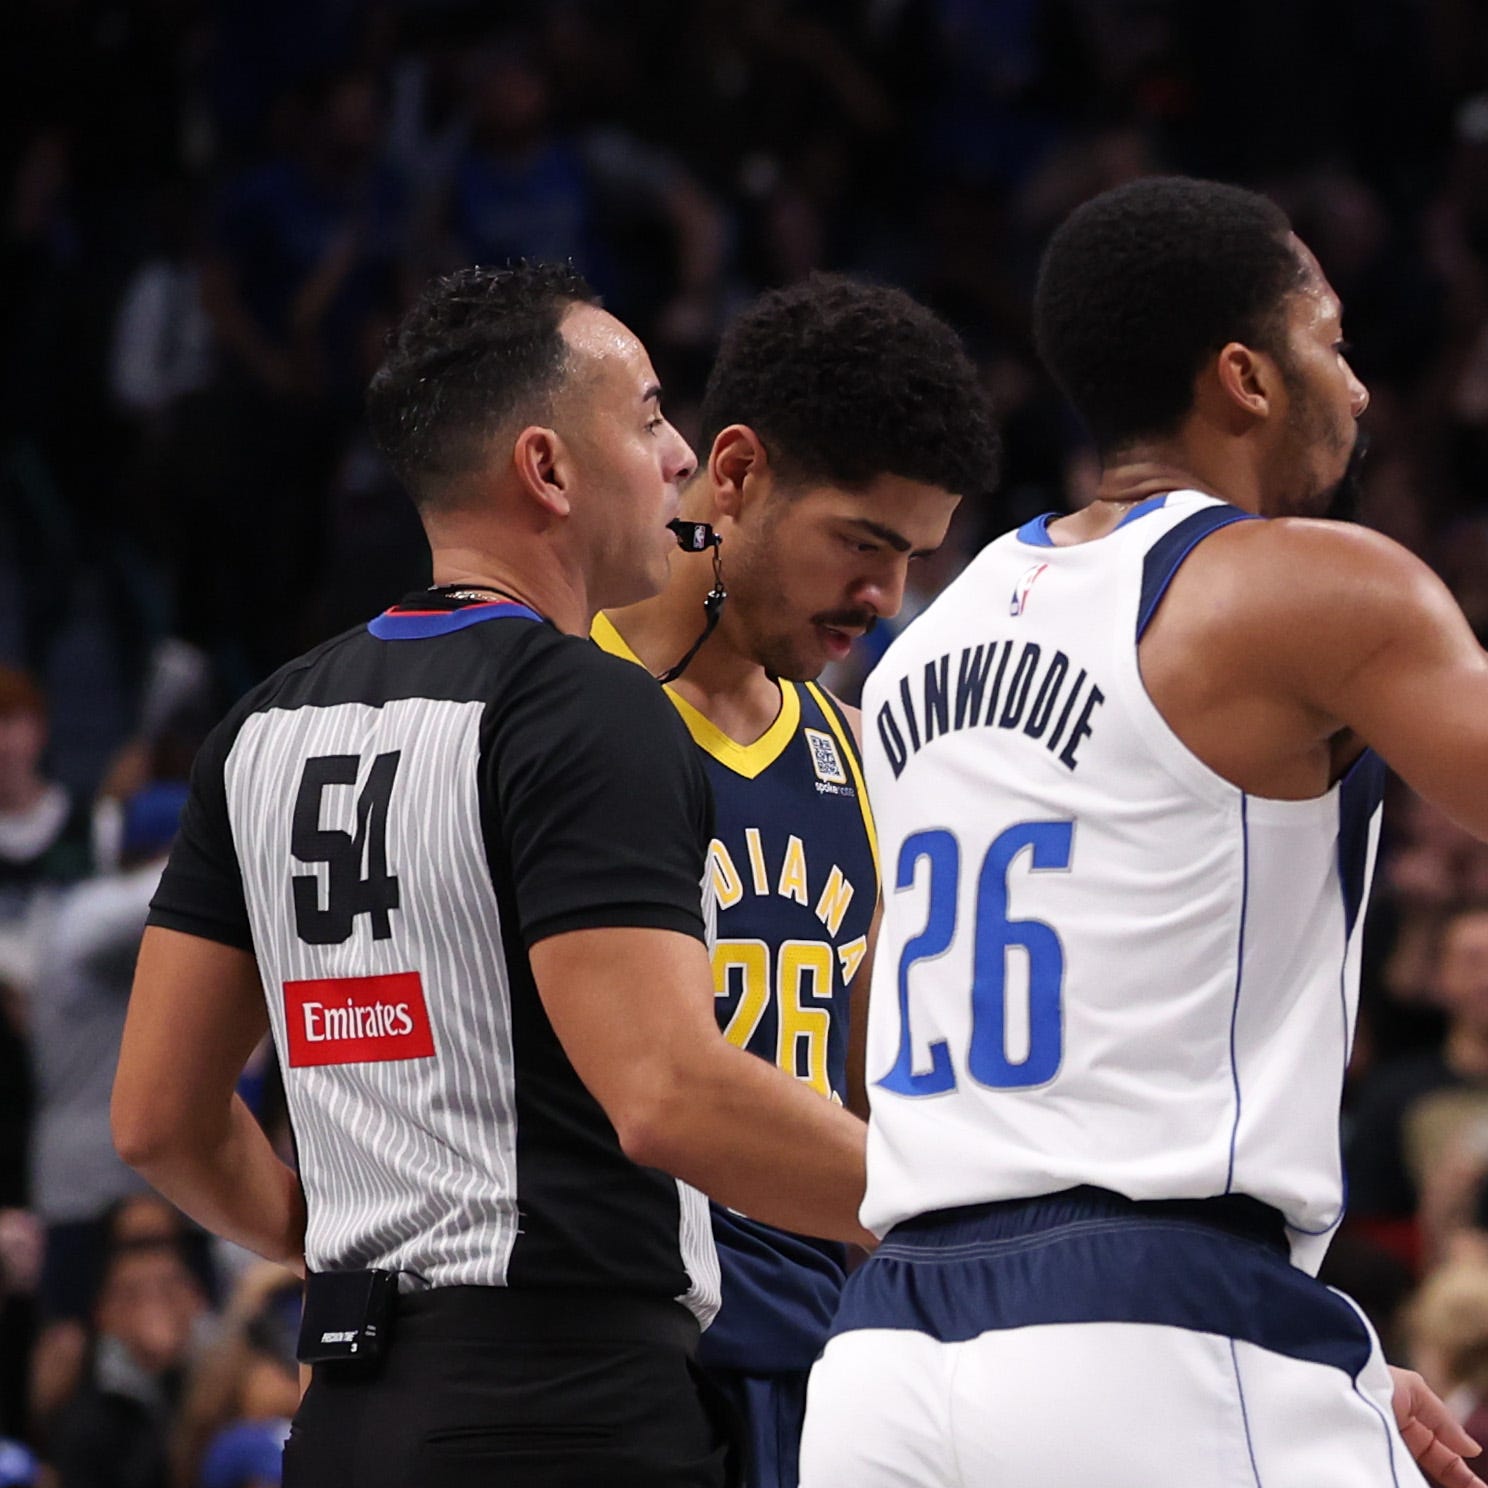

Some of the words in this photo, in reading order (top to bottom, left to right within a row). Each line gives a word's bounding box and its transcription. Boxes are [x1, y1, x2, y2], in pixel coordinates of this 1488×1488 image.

[877, 640, 1105, 780] DINWIDDIE
[291, 750, 401, 945] 54
[706, 827, 867, 986] DIANA
[302, 997, 414, 1042] Emirates
[711, 938, 834, 1101] 26
[871, 818, 1077, 1098] 26
